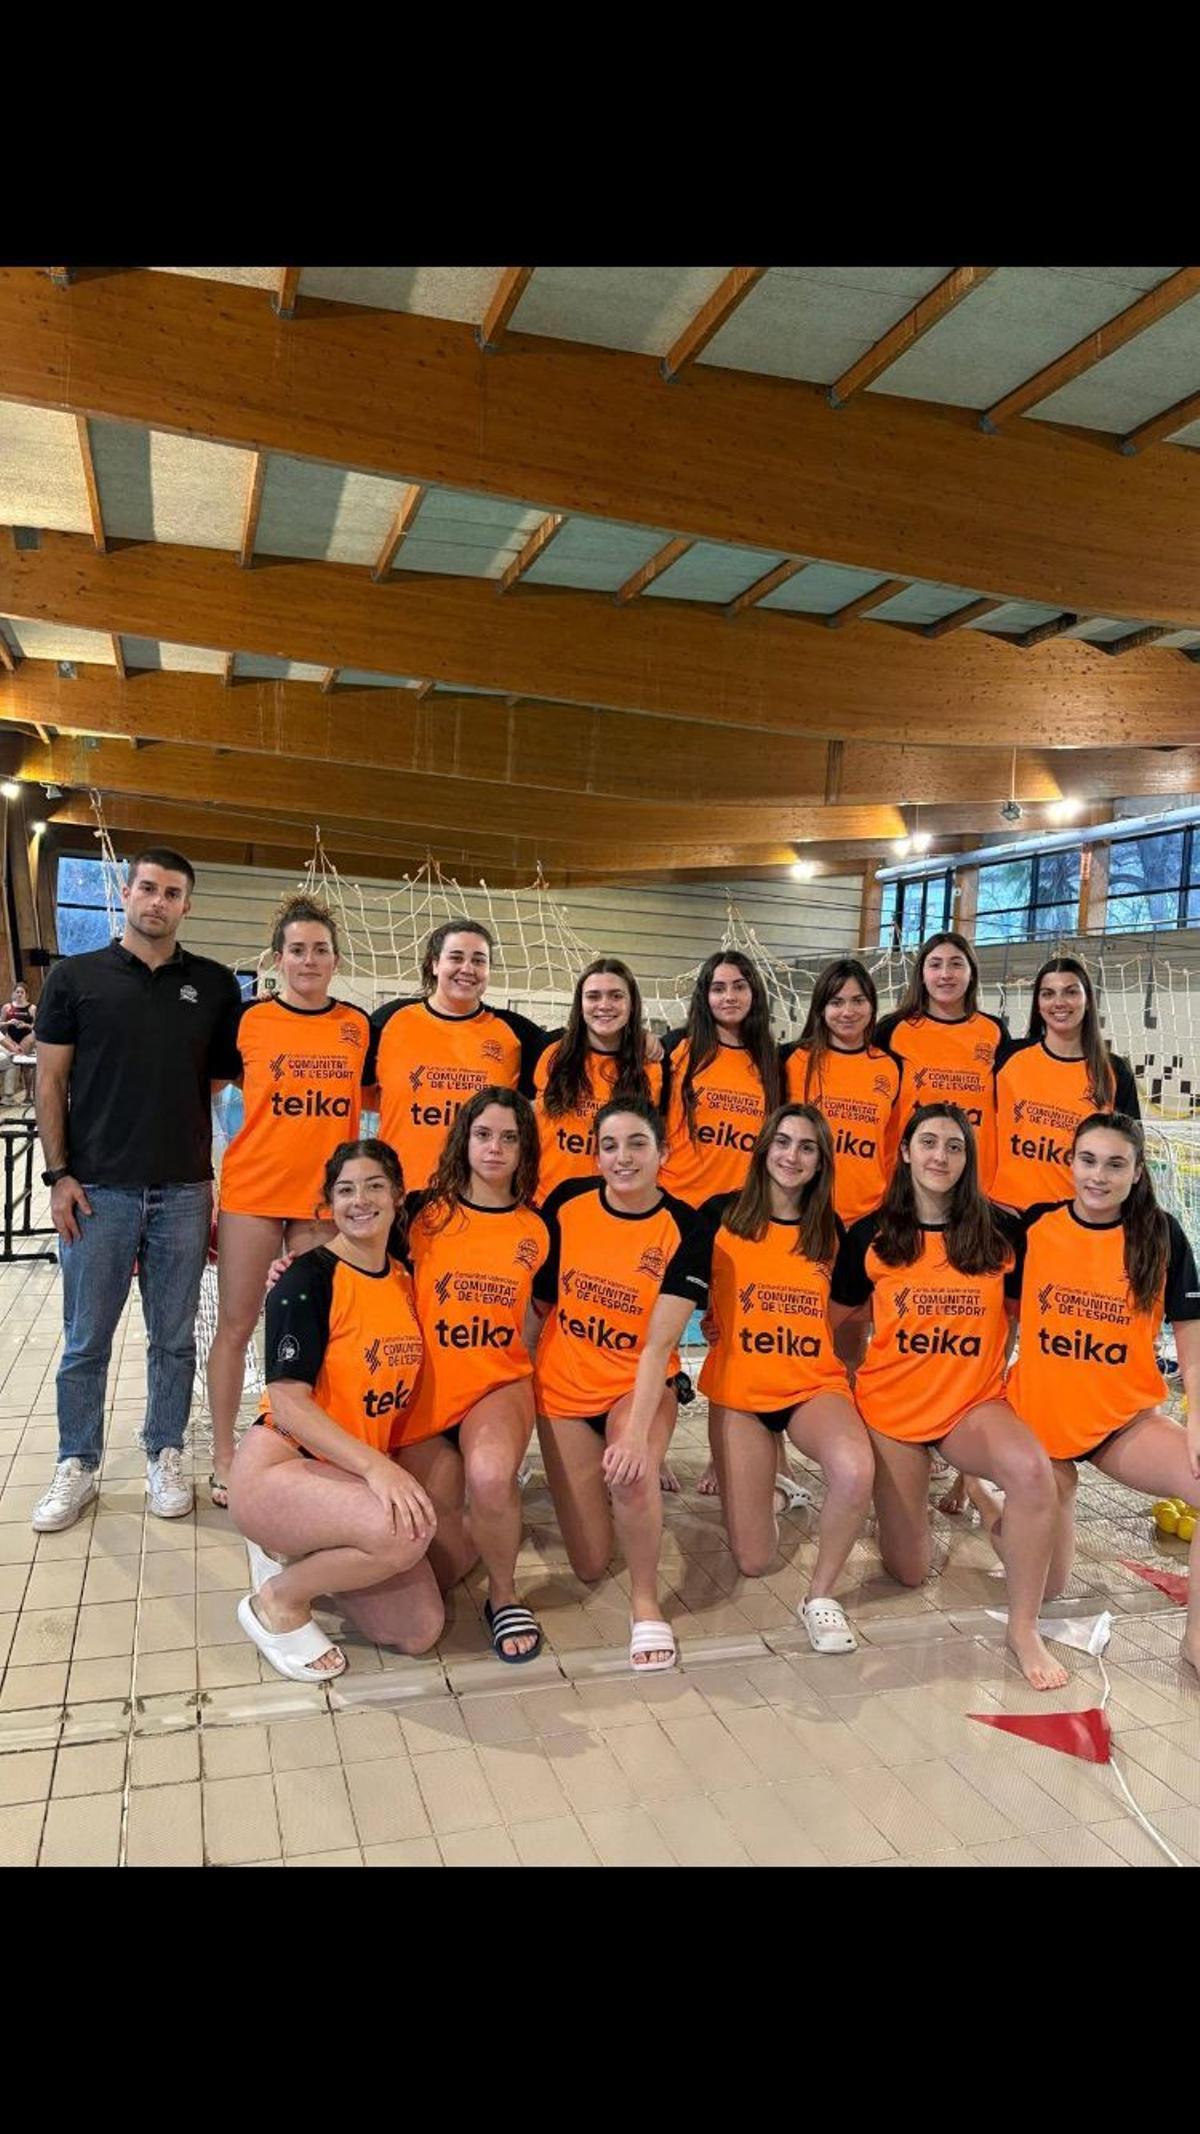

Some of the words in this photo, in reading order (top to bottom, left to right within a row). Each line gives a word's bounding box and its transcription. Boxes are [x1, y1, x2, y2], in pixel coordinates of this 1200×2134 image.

[293, 1070, 306, 1078] DE
[271, 1089, 351, 1117] teika
[411, 1100, 460, 1126] tei
[556, 1128, 594, 1155] tei
[697, 1121, 758, 1152] eika
[836, 1129, 876, 1159] ika
[453, 1280, 516, 1297] COMUNITAT
[458, 1291, 472, 1301] DE
[475, 1293, 516, 1308] L'ESPORT
[575, 1278, 638, 1304] COMUNITAT
[757, 1291, 818, 1306] COMUNITAT
[912, 1294, 980, 1305] COMUNITAT
[576, 1290, 591, 1301] DE
[593, 1295, 643, 1315] L'ESPORT
[761, 1301, 775, 1312] DE
[778, 1303, 824, 1319] L'ESPORT
[917, 1305, 933, 1316] DE
[935, 1305, 986, 1317] L'ESPORT
[1054, 1292, 1124, 1314] COMUNITAT
[1058, 1303, 1075, 1316] DE
[1077, 1308, 1130, 1325] L'ESPORT
[435, 1315, 515, 1349] teika
[559, 1309, 638, 1350] teika
[739, 1326, 821, 1357] teika
[895, 1327, 981, 1357] teika
[1038, 1328, 1127, 1365] teika
